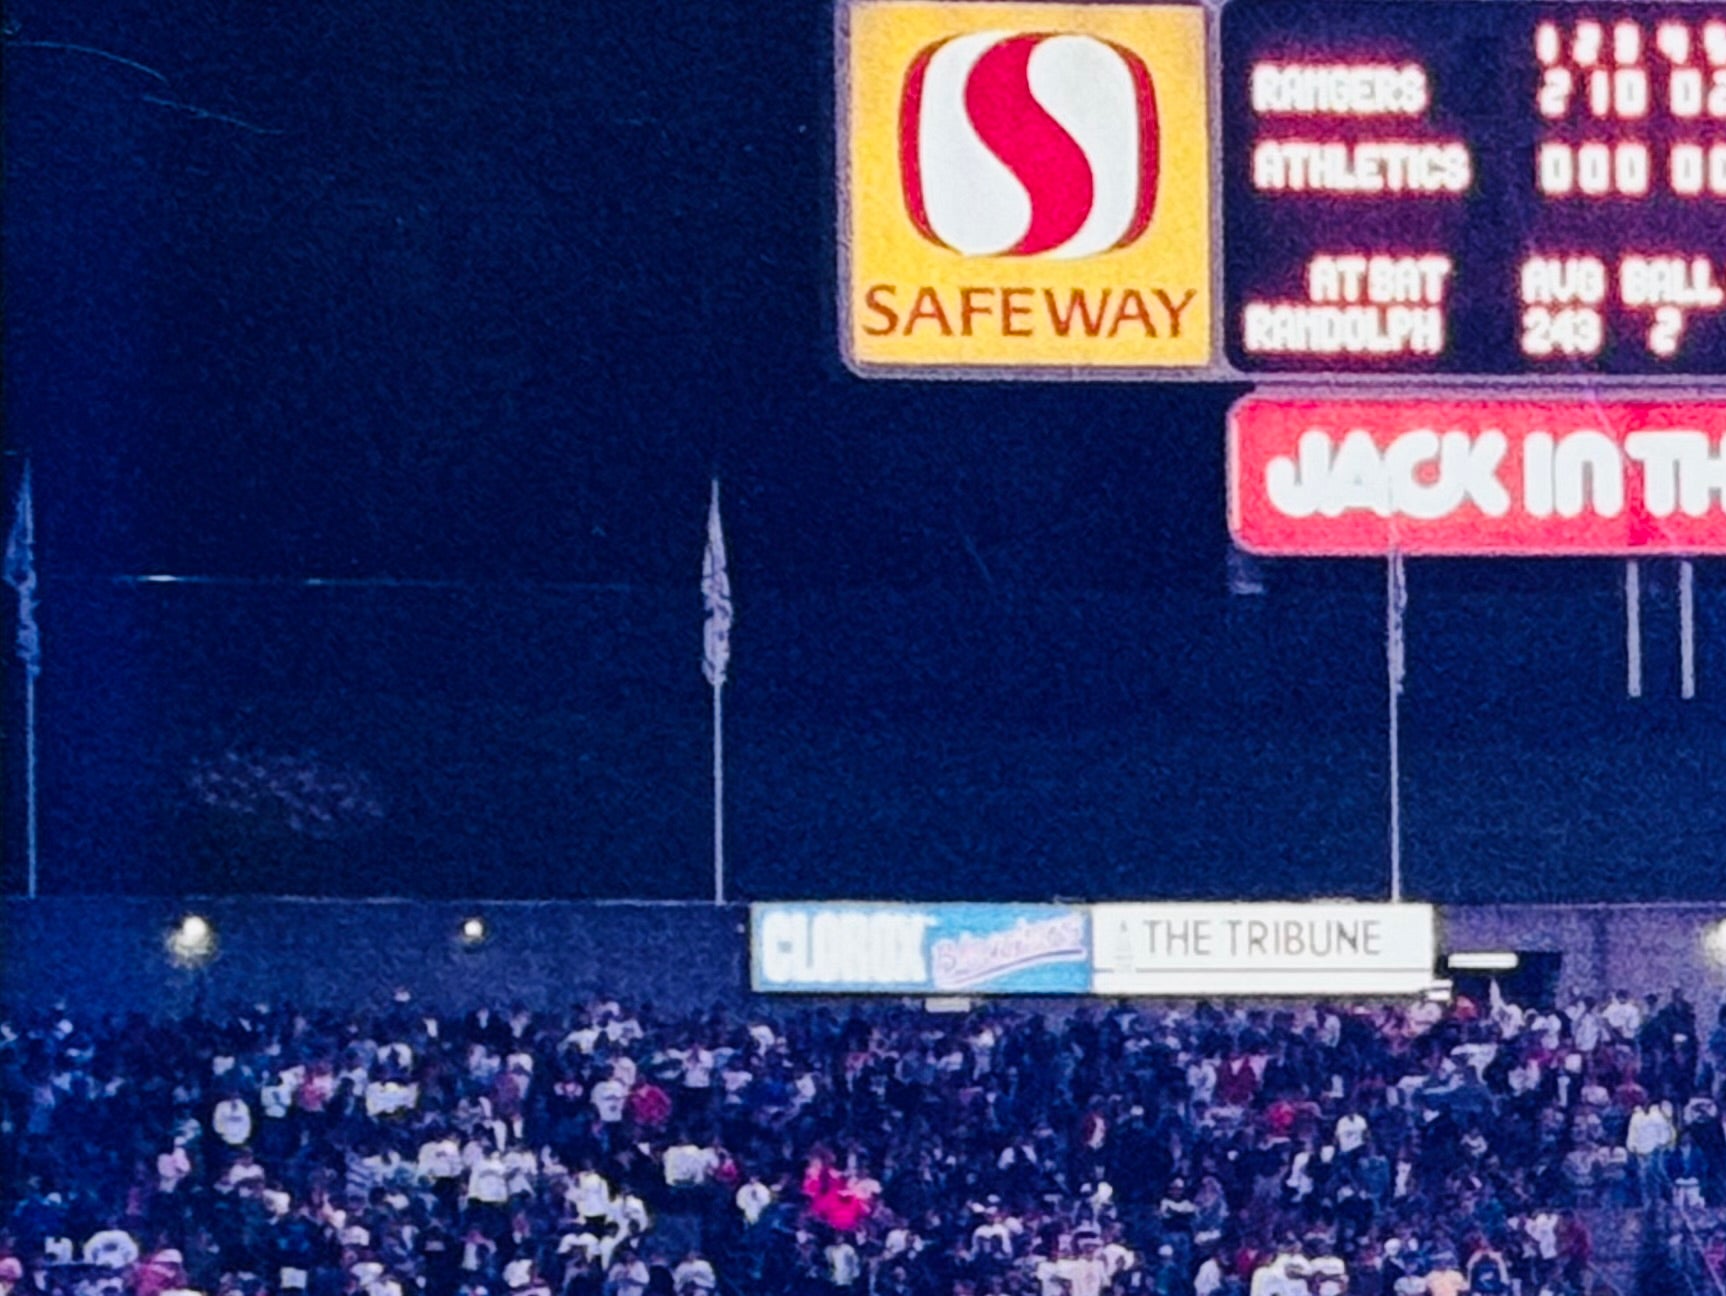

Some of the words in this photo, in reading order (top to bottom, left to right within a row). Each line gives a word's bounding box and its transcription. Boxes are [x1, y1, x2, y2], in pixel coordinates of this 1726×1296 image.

[1252, 64, 1427, 114] RANGERS
[1255, 141, 1471, 191] ATHLETICS
[1309, 256, 1368, 301] AT
[1369, 256, 1451, 302] BAT
[1621, 257, 1723, 305] BALL
[862, 283, 1199, 339] SAFEWAY
[1245, 305, 1442, 353] RANDOLPH
[1522, 307, 1602, 355] 243
[1649, 306, 1682, 354] 2
[1266, 428, 1511, 519] JACK
[1141, 918, 1214, 957] THE
[1225, 917, 1384, 958] TRIBUNE
